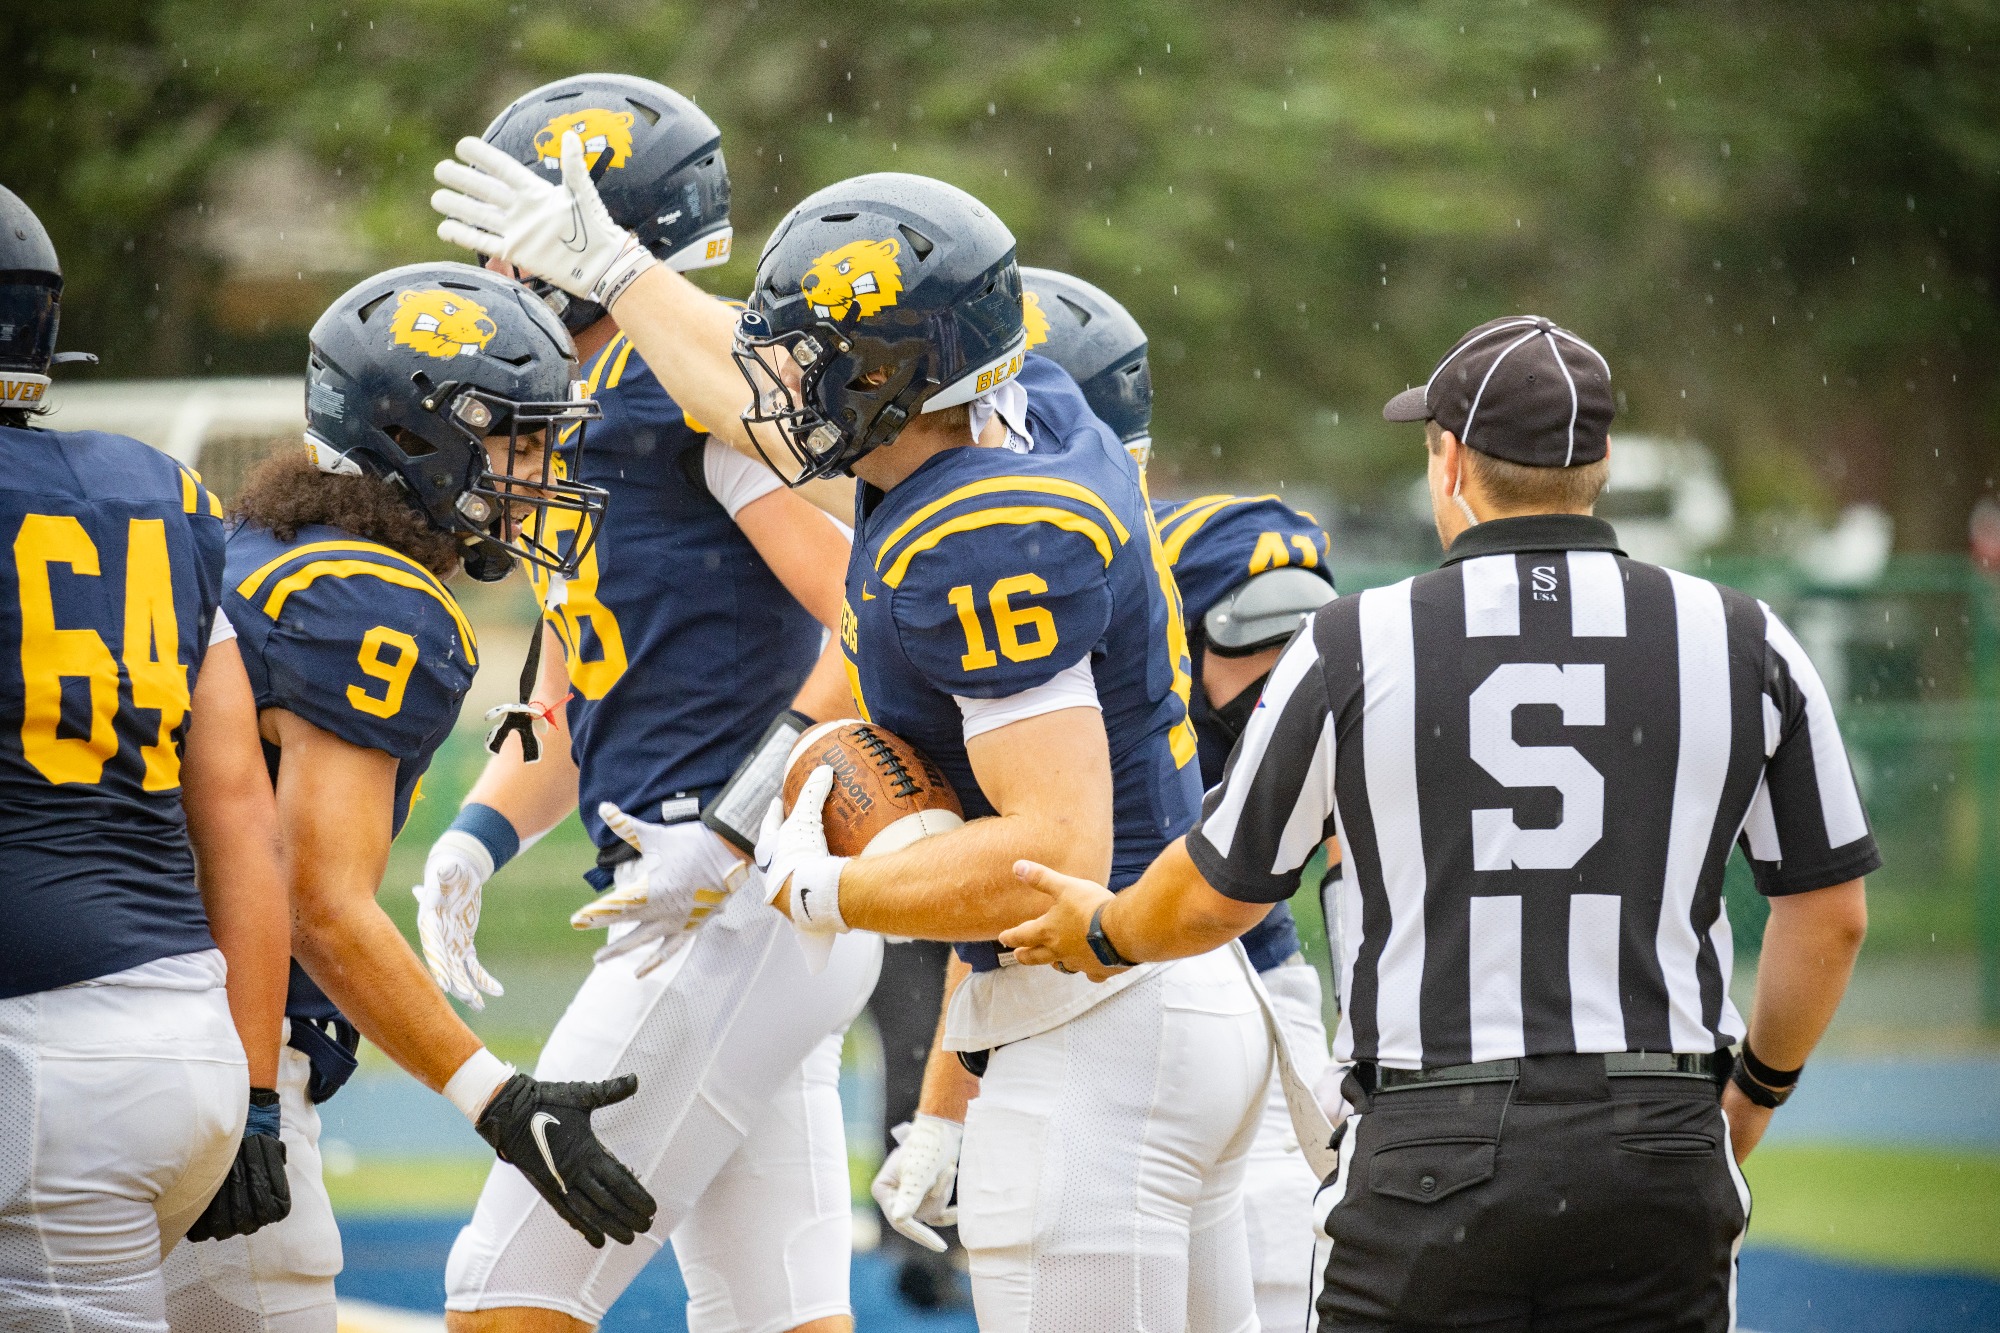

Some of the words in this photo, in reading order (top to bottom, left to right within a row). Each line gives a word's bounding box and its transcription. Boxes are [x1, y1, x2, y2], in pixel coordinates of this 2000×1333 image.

[841, 597, 858, 654] ERS
[947, 572, 1059, 671] 16
[1533, 592, 1558, 602] USA
[13, 513, 191, 791] 64
[346, 625, 419, 719] 9
[821, 744, 875, 813] Wilson
[1469, 663, 1606, 871] S
